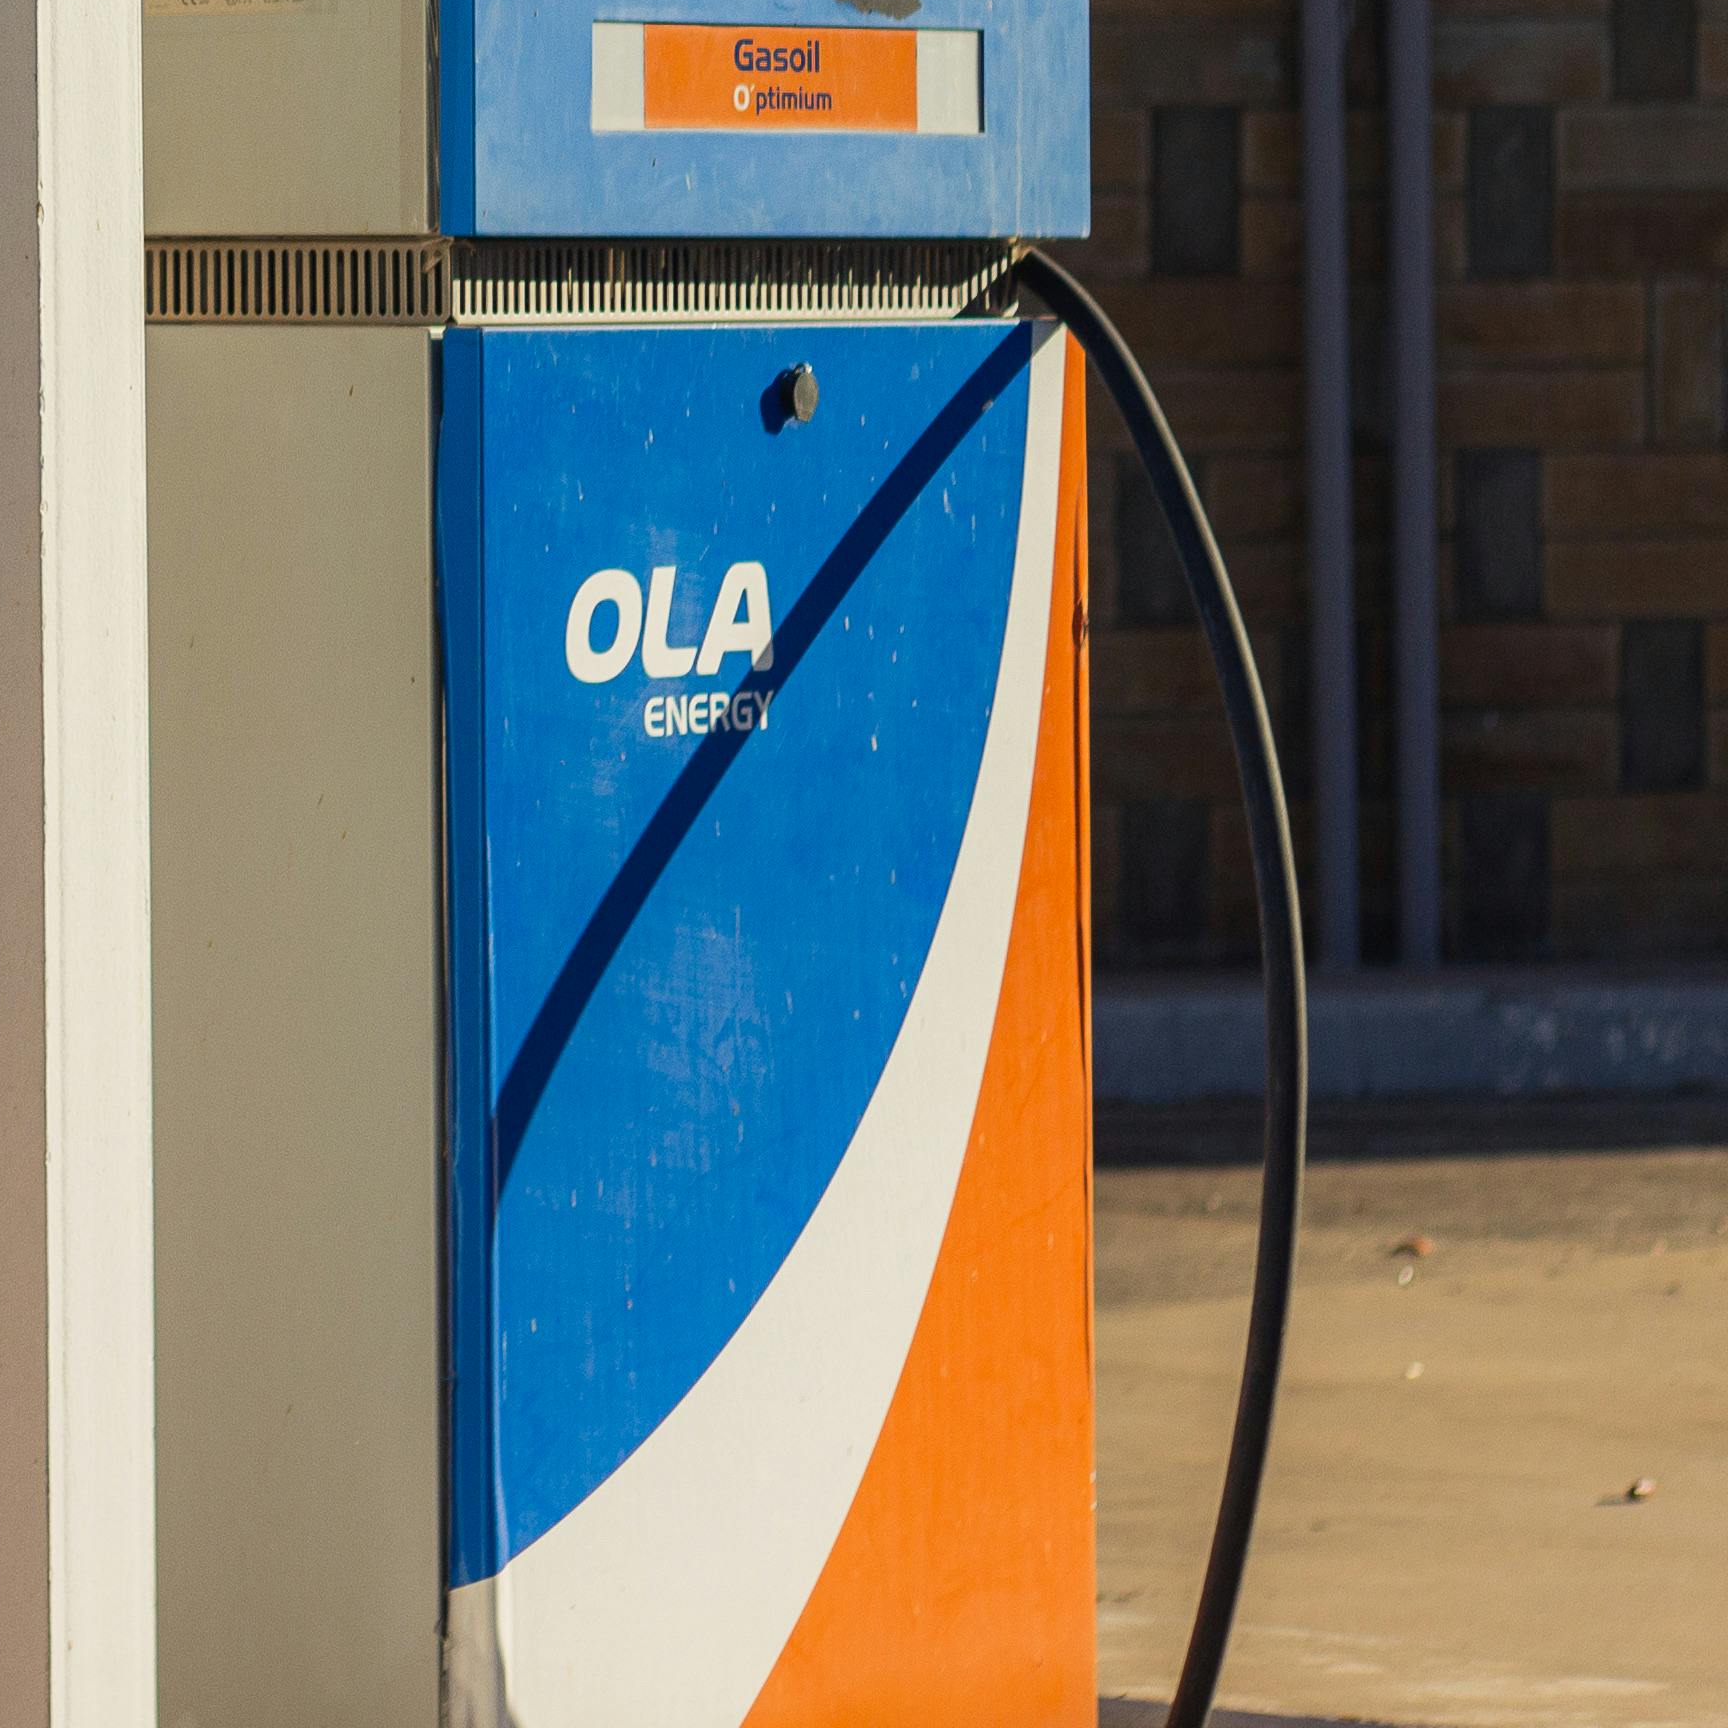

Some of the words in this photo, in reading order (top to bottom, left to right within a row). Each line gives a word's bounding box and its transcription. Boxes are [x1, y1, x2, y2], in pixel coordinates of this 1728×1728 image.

[734, 38, 820, 73] Gasoil
[565, 560, 774, 684] OLA
[644, 690, 775, 738] ENERGY
